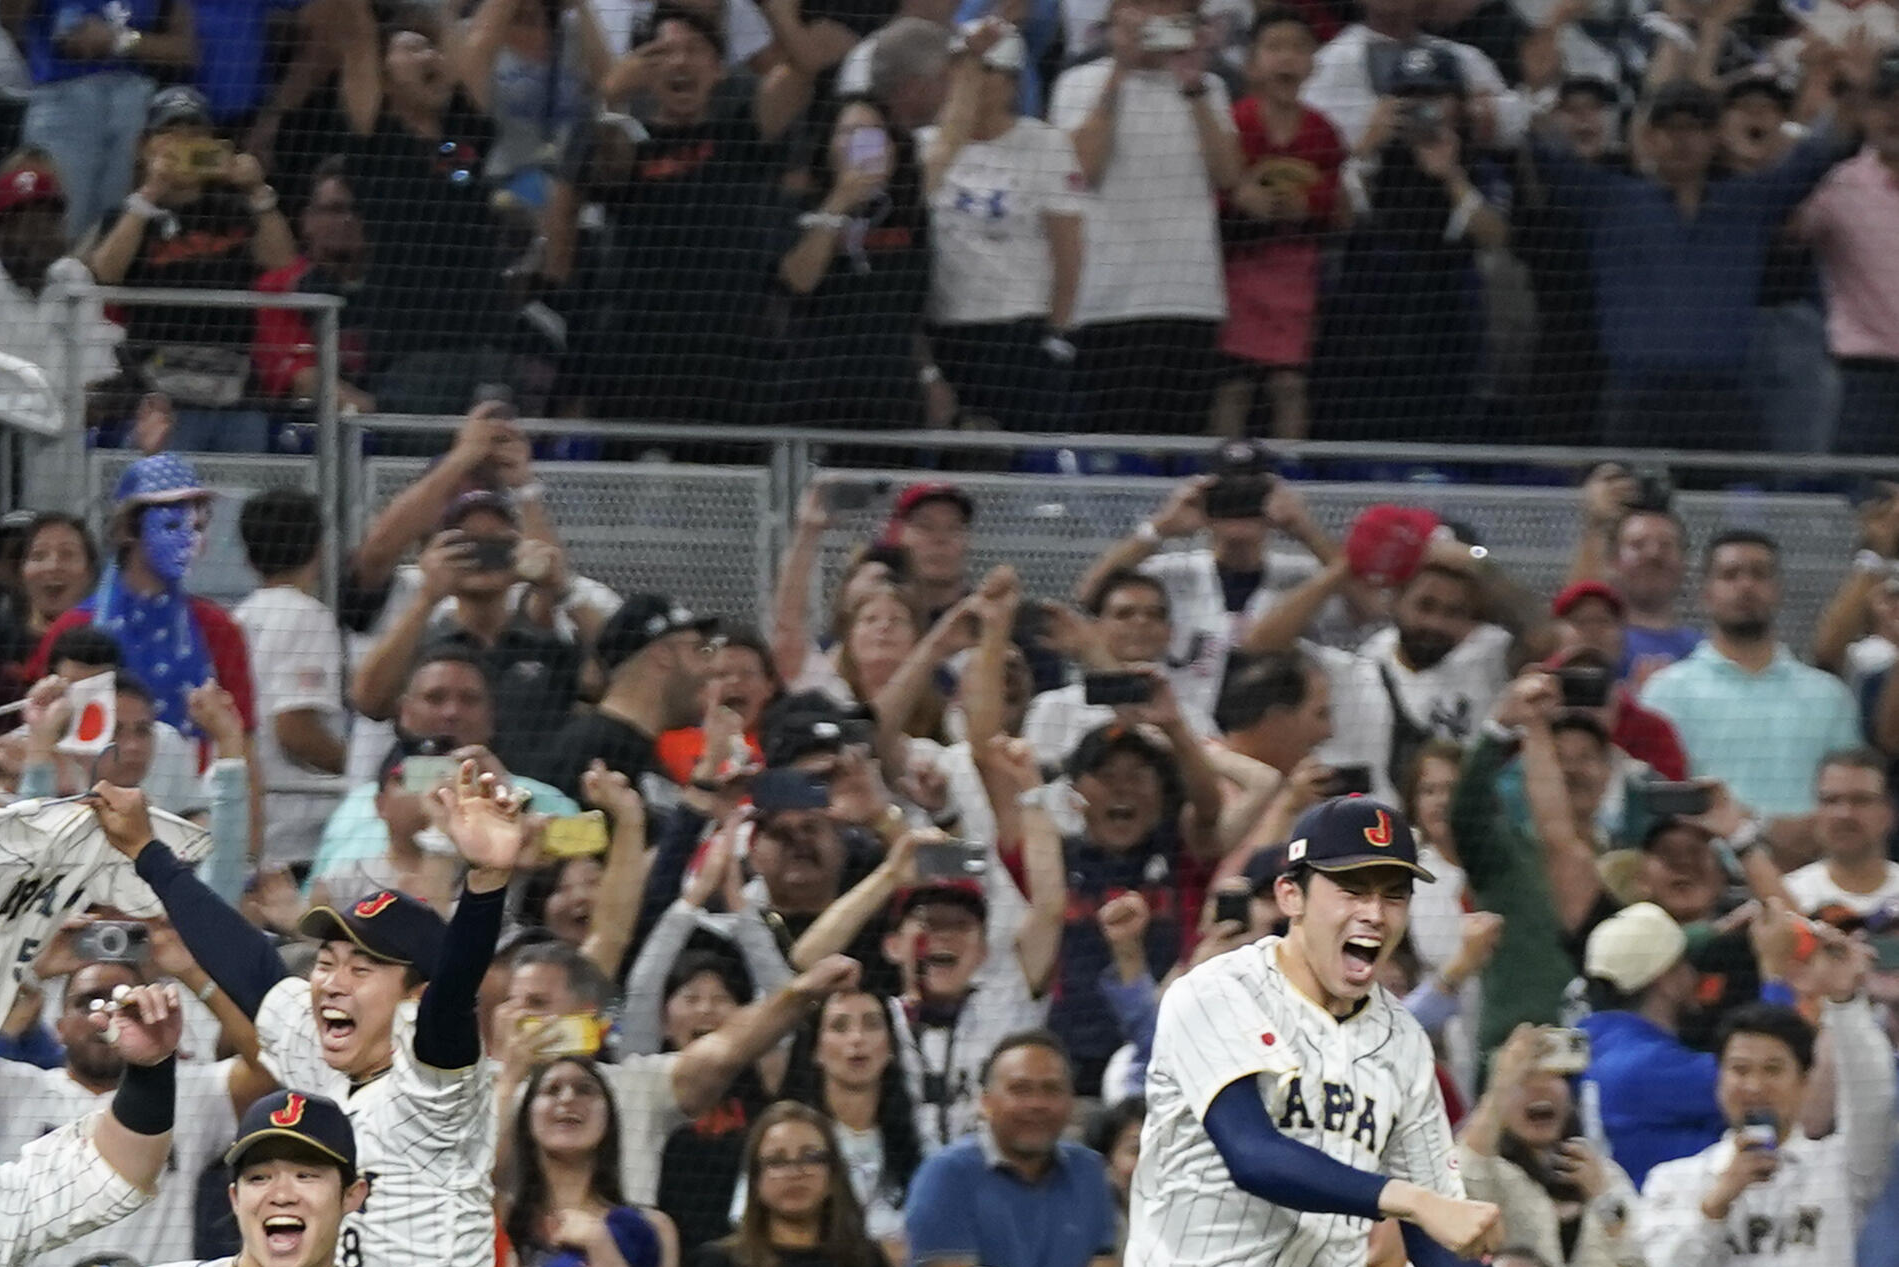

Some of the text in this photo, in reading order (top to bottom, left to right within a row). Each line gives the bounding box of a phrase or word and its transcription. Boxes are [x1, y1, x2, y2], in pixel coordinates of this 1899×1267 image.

[1363, 809, 1393, 847] J
[269, 1092, 306, 1127] J
[1278, 1076, 1399, 1160] APA
